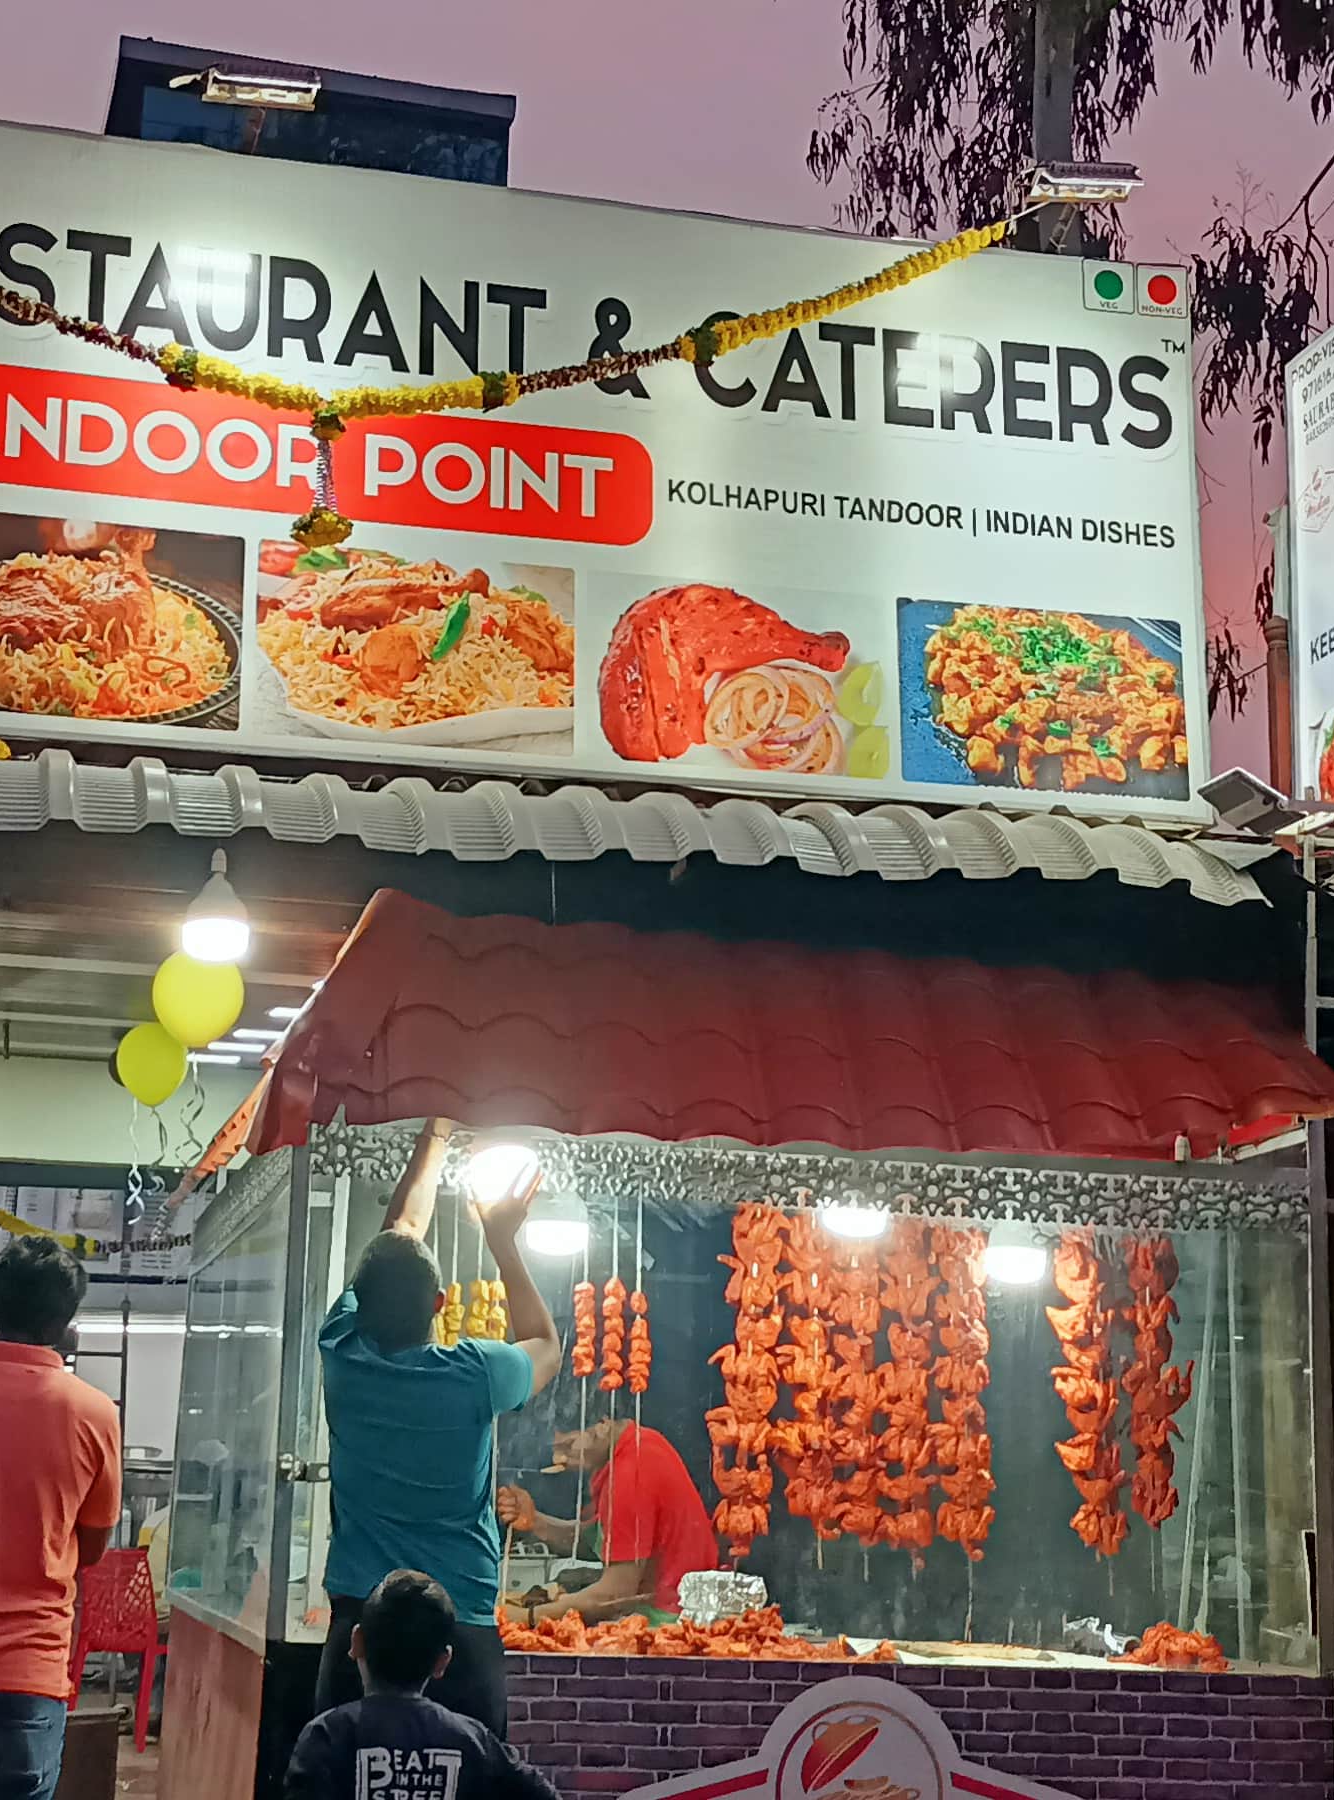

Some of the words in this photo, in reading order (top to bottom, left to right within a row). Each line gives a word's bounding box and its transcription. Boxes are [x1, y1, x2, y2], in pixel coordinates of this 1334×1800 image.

[1100, 301, 1119, 310] VEG
[1141, 305, 1183, 316] NON-VEG
[587, 296, 651, 400] &
[693, 311, 1172, 450] CATERERS
[363, 431, 614, 519] POINT
[667, 478, 825, 518] KOLHAPURI
[834, 496, 964, 530] TANDOOR
[986, 509, 1073, 540] INDIAN
[1081, 518, 1176, 549] DISHES
[395, 1772, 409, 1786] IN
[412, 1773, 444, 1787] THE
